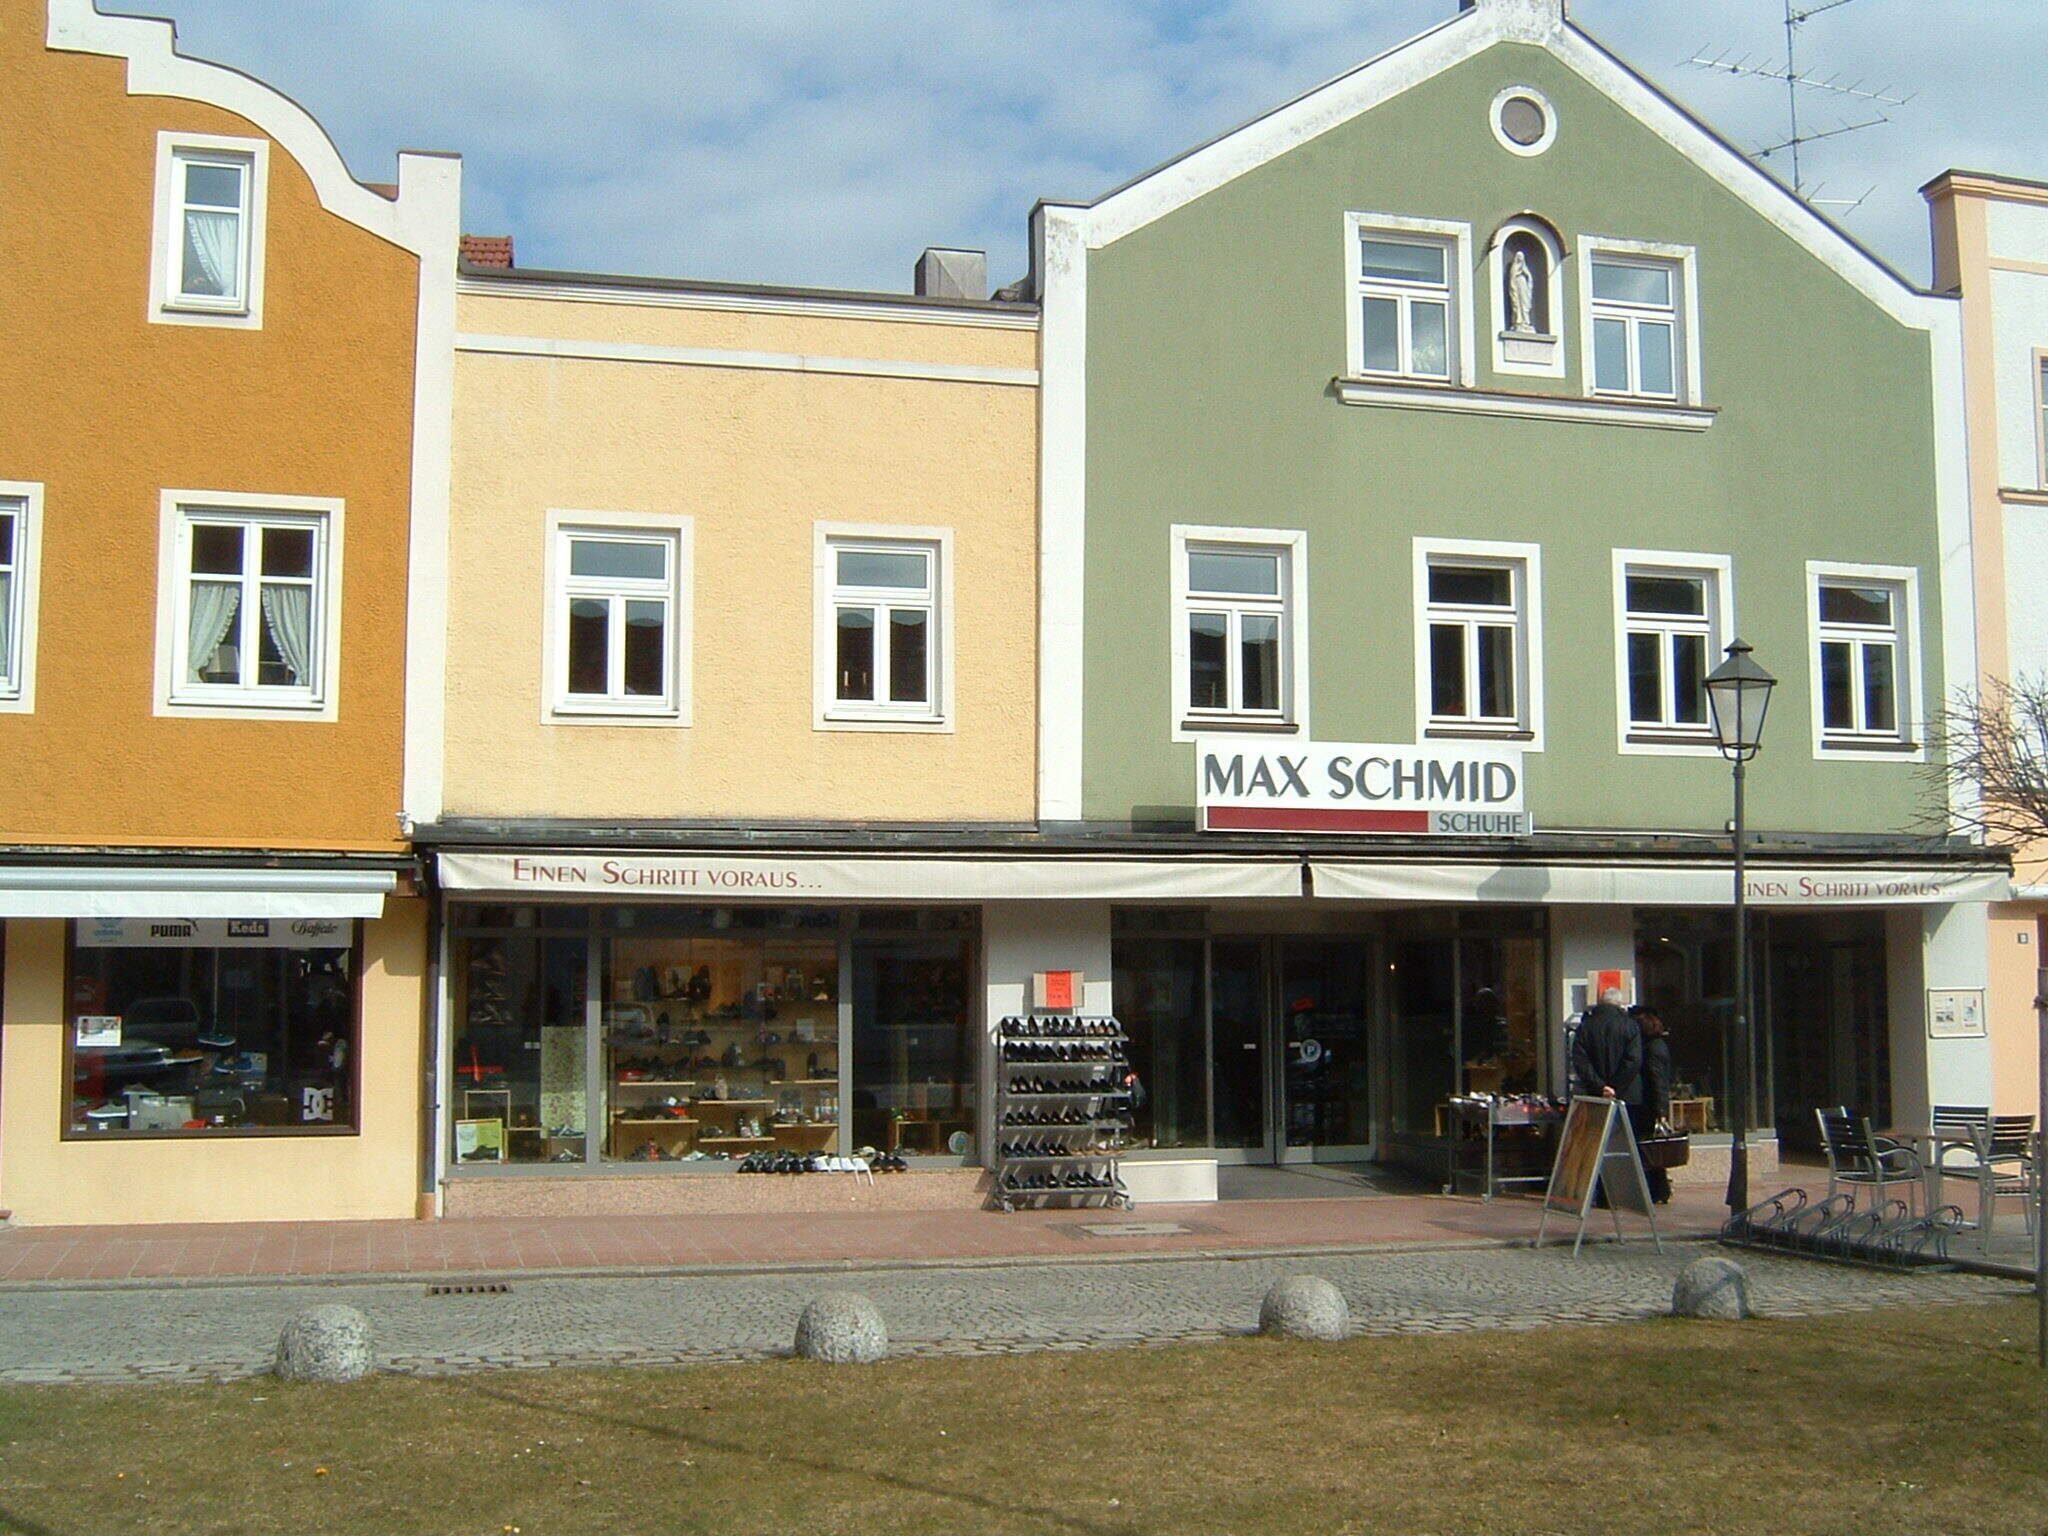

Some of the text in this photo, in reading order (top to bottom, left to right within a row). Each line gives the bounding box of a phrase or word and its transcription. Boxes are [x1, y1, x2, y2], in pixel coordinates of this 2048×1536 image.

[1204, 754, 1517, 803] MAX SCHMID
[1439, 813, 1523, 834] SCHUHE
[512, 858, 587, 883] EINEN
[602, 861, 700, 886] SCHRITT
[1747, 882, 1788, 897] INEN
[1799, 876, 1868, 898] SCHRITT
[151, 925, 191, 938] PUMA
